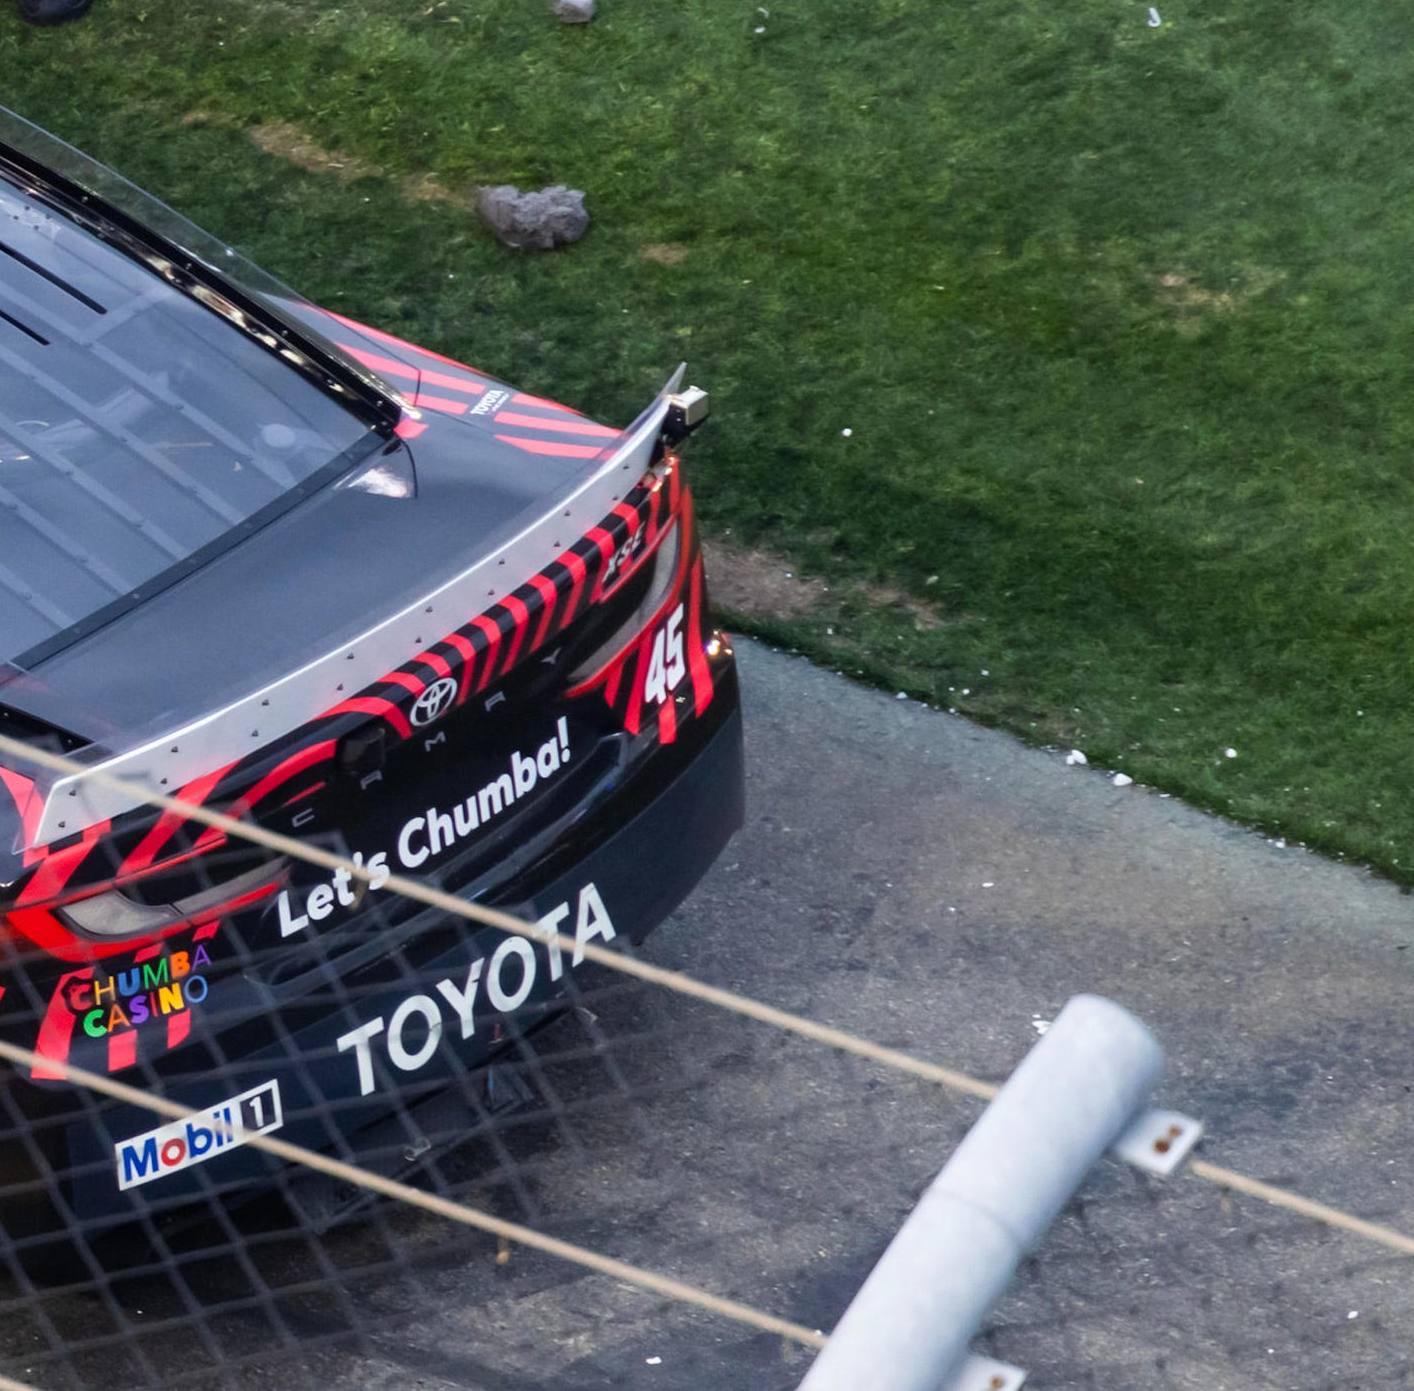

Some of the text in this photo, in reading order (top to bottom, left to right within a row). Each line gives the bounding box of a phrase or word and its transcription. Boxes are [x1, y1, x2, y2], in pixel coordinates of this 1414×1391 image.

[644, 602, 686, 705] 45
[276, 715, 572, 938] Let's Chumba!
[68, 944, 213, 1011] CHUMBA
[82, 974, 209, 1039] CASINO
[336, 882, 617, 1097] TOYOTA
[121, 1106, 234, 1183] Mobil
